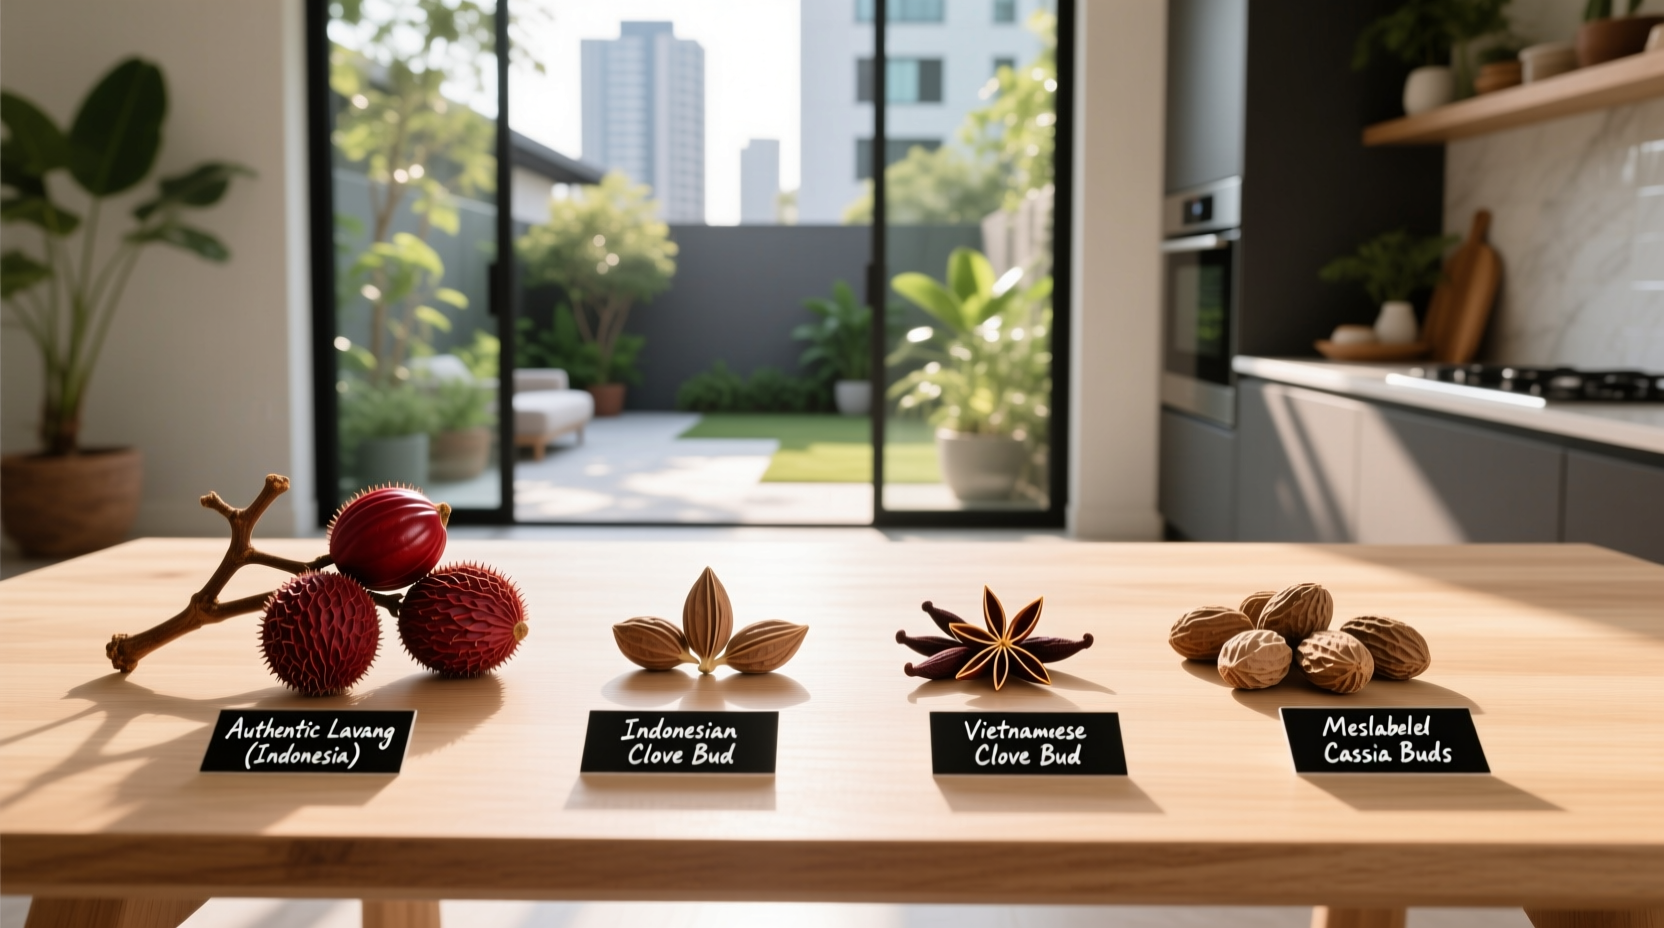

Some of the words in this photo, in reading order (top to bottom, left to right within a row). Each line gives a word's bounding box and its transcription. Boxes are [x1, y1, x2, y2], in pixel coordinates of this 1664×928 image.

[224, 716, 321, 740] Authentic
[326, 718, 396, 751] Lavang
[620, 718, 738, 741] Indonesian
[244, 741, 361, 770] (Indonesia)
[628, 742, 684, 766] Clove
[691, 742, 737, 766] Bud
[974, 743, 1031, 766] Clove
[1039, 743, 1083, 767] Bud
[1324, 741, 1393, 764] Cassia
[1399, 740, 1453, 763] Buds
